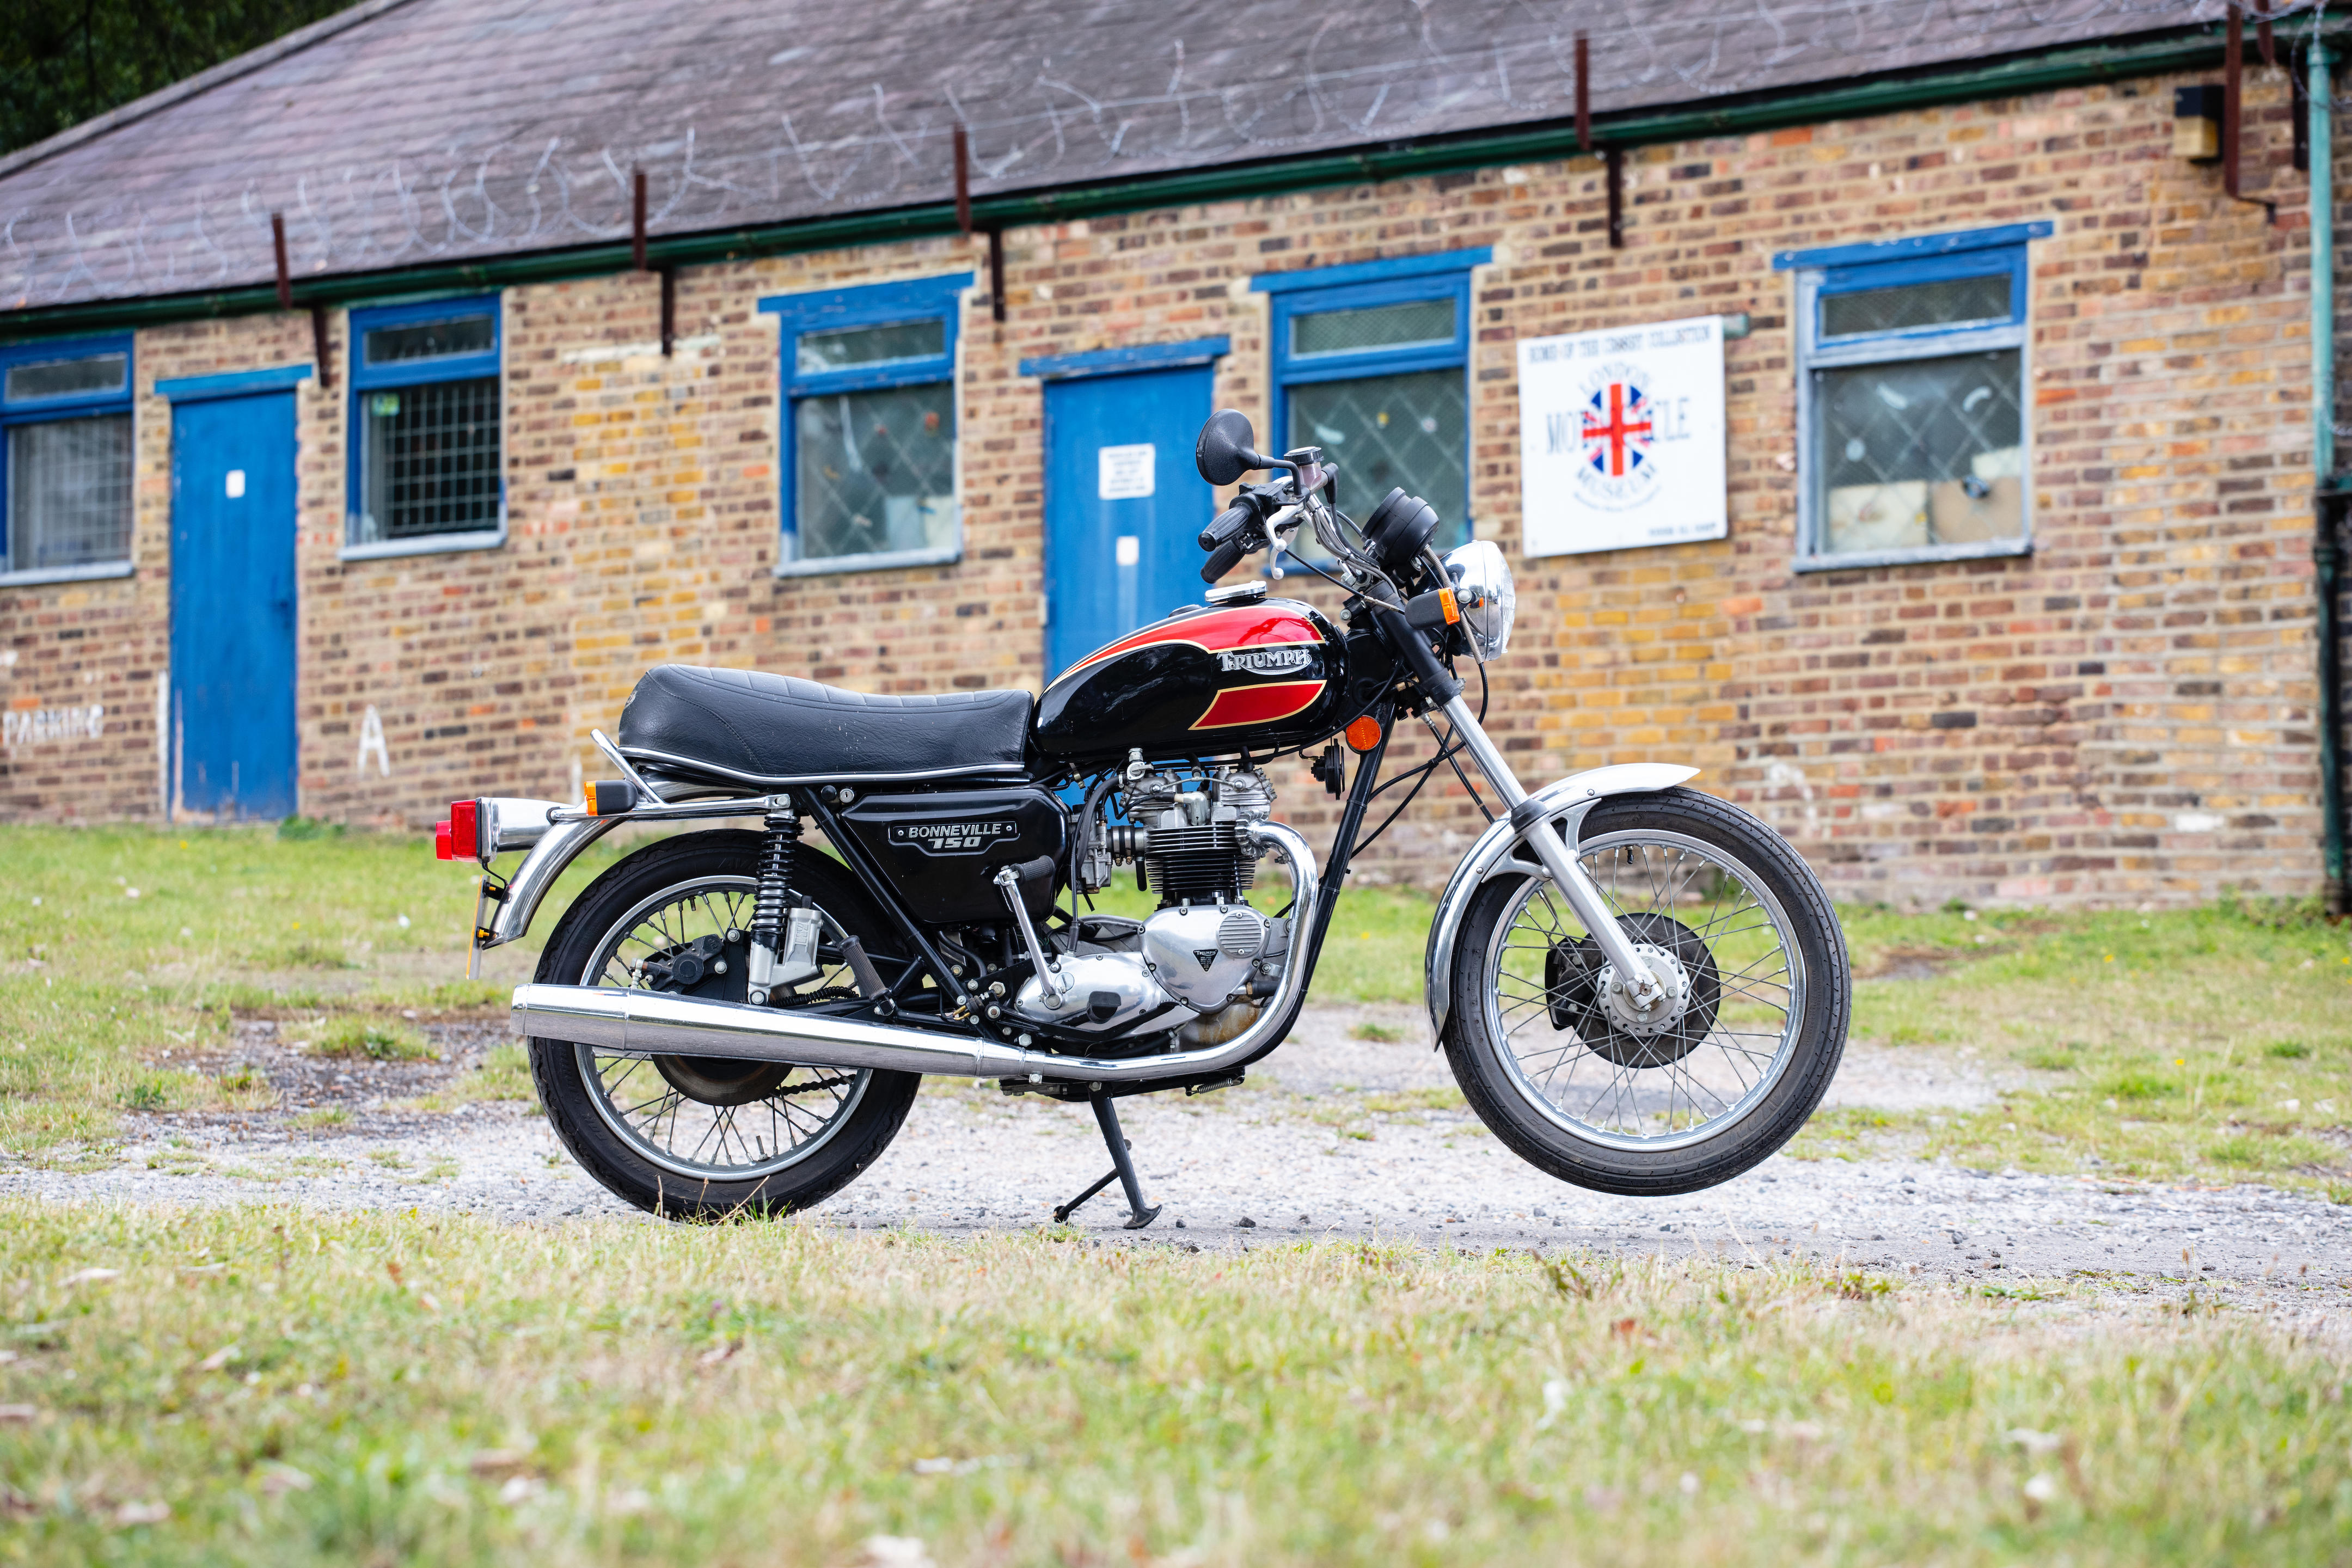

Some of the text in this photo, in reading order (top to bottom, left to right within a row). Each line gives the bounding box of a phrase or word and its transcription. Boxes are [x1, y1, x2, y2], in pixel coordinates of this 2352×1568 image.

[1578, 361, 1653, 396] LONDON
[1575, 463, 1657, 497] MUSEUM
[1216, 649, 1313, 675] TRIUMPH
[357, 704, 390, 777] A
[908, 823, 1002, 838] BONNEVILLE
[928, 836, 981, 849] 750
